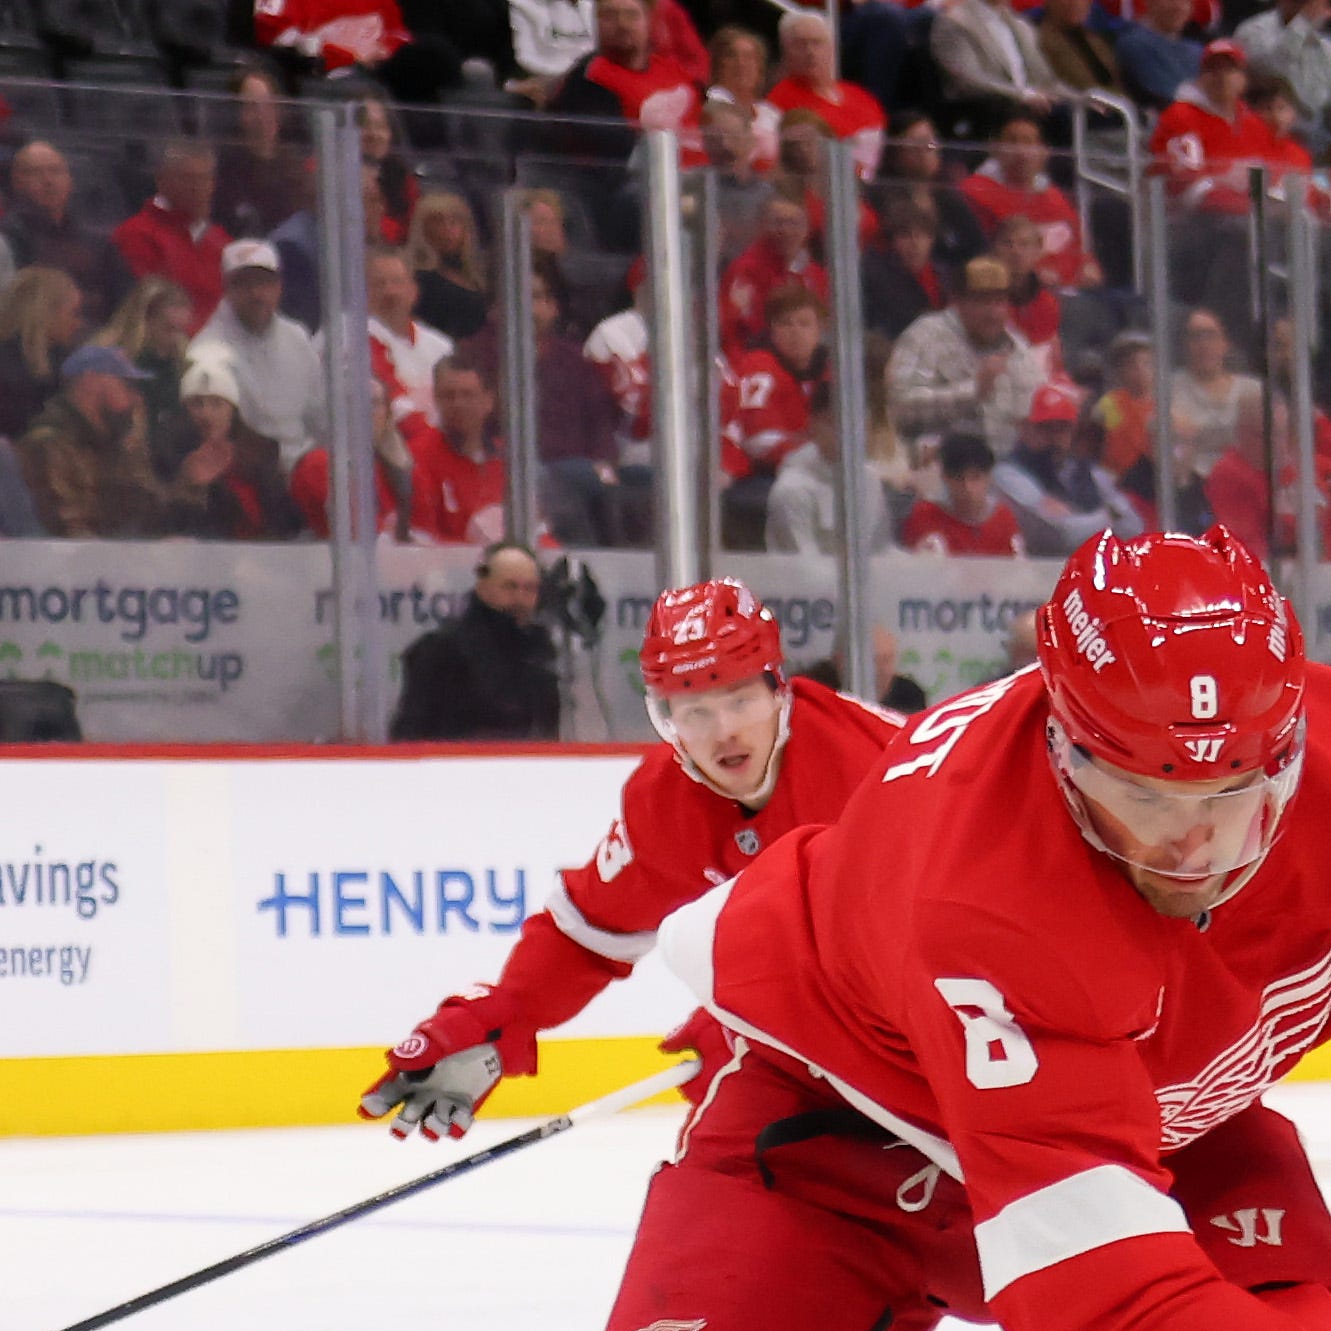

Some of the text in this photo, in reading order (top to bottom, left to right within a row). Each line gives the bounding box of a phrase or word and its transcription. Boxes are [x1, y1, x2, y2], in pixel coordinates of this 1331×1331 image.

[0, 580, 240, 643] mortgage
[1063, 588, 1117, 674] meijer
[1189, 675, 1220, 720] 8
[256, 867, 527, 938] HENRY
[934, 977, 1039, 1090] 8
